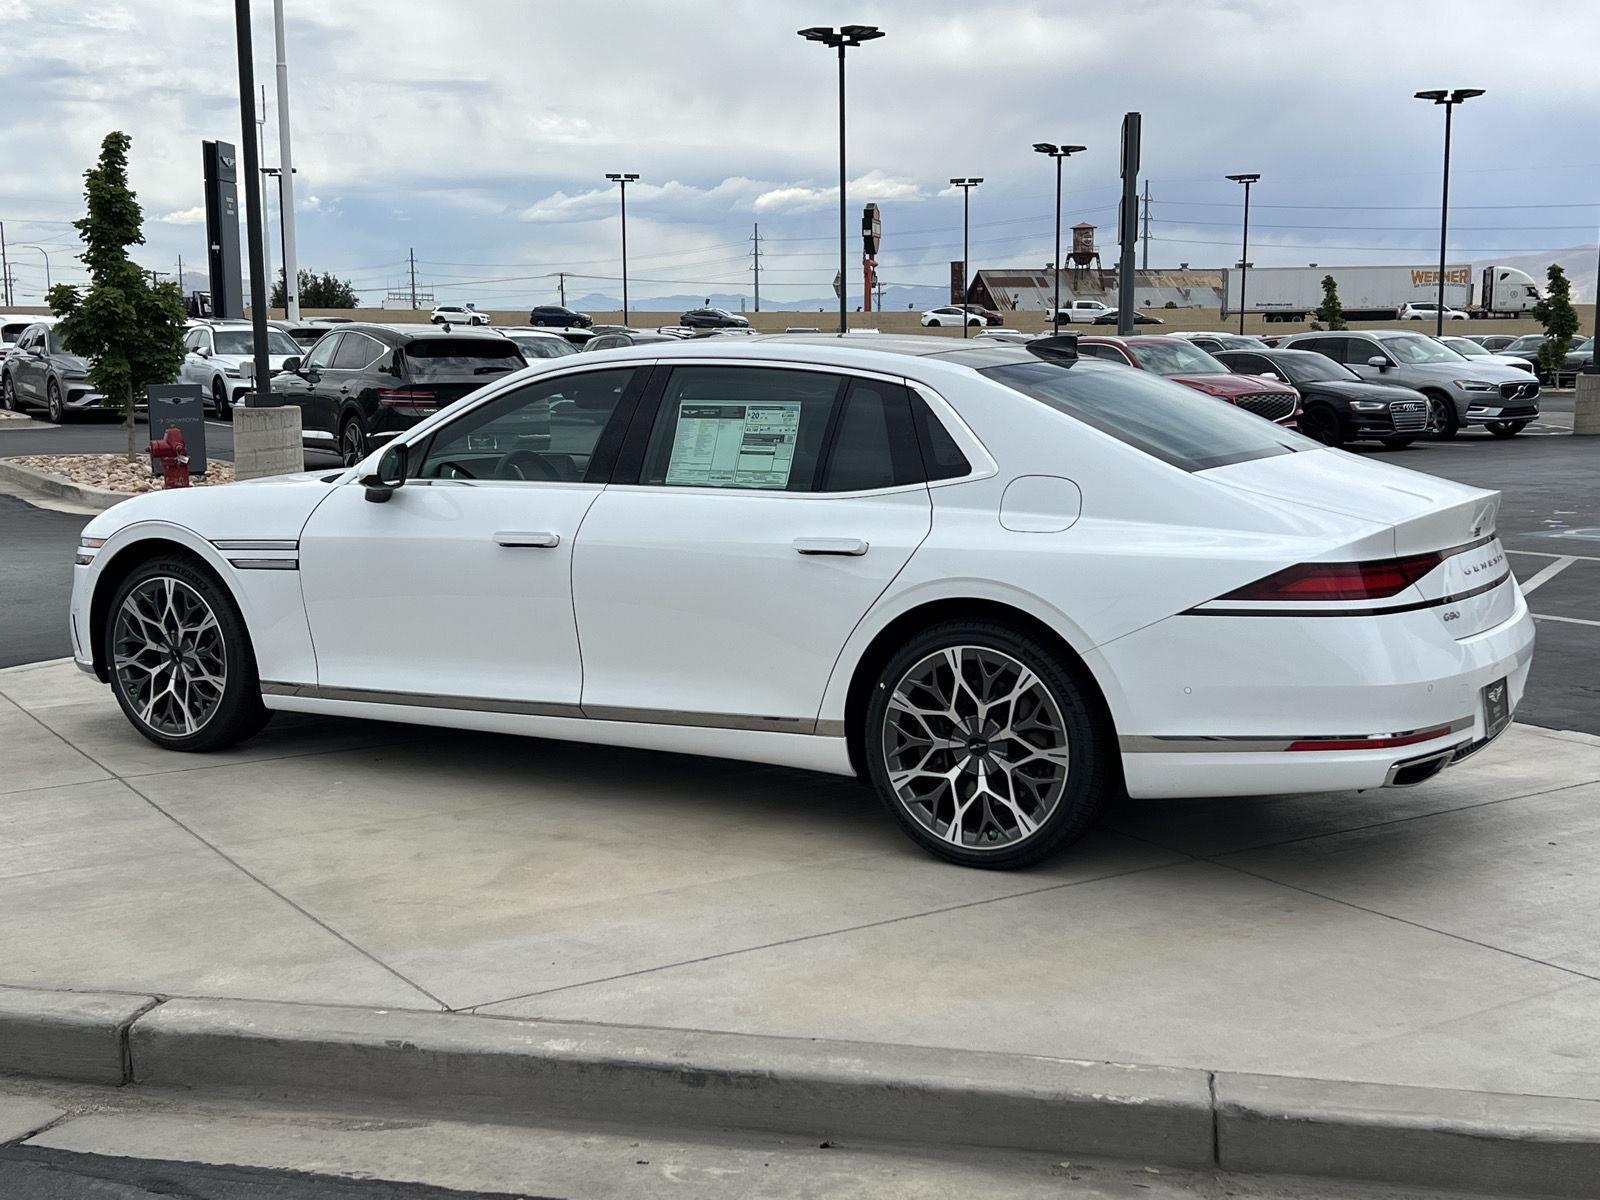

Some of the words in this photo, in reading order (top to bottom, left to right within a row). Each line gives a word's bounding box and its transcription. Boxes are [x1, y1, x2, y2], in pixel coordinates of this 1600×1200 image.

[1411, 269, 1468, 284] WERNER
[751, 411, 760, 419] 20
[1463, 554, 1503, 576] GENESIS
